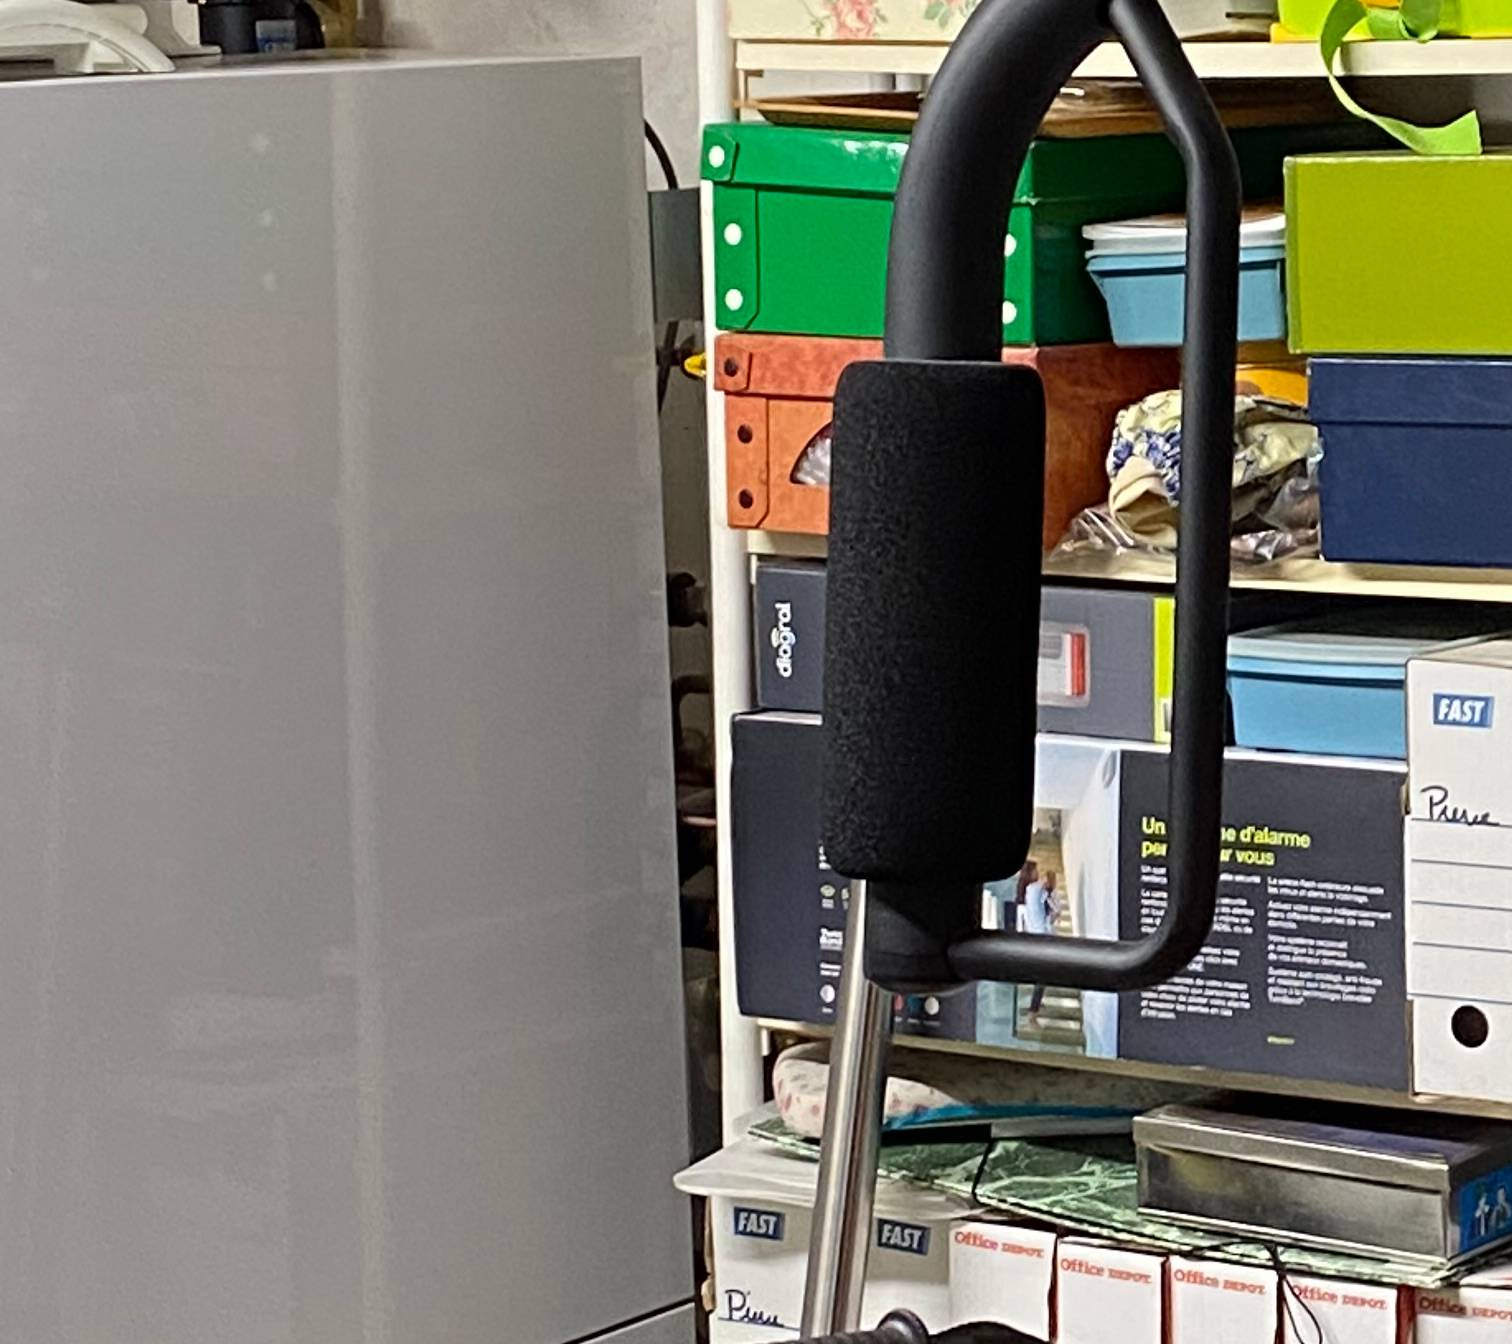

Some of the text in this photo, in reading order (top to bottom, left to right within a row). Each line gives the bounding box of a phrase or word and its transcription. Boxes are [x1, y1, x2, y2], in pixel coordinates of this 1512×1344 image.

[1437, 698, 1486, 724] FAST
[1142, 816, 1166, 835] Un
[1240, 826, 1311, 849] d'alarme
[1235, 849, 1275, 866] vous
[736, 1213, 778, 1235] FAST
[880, 1225, 924, 1249] FAST
[954, 1230, 999, 1251] Office
[1060, 1258, 1105, 1277] Office
[1174, 1268, 1220, 1289] Office
[1292, 1283, 1339, 1305] Office
[1418, 1296, 1467, 1317] Office
